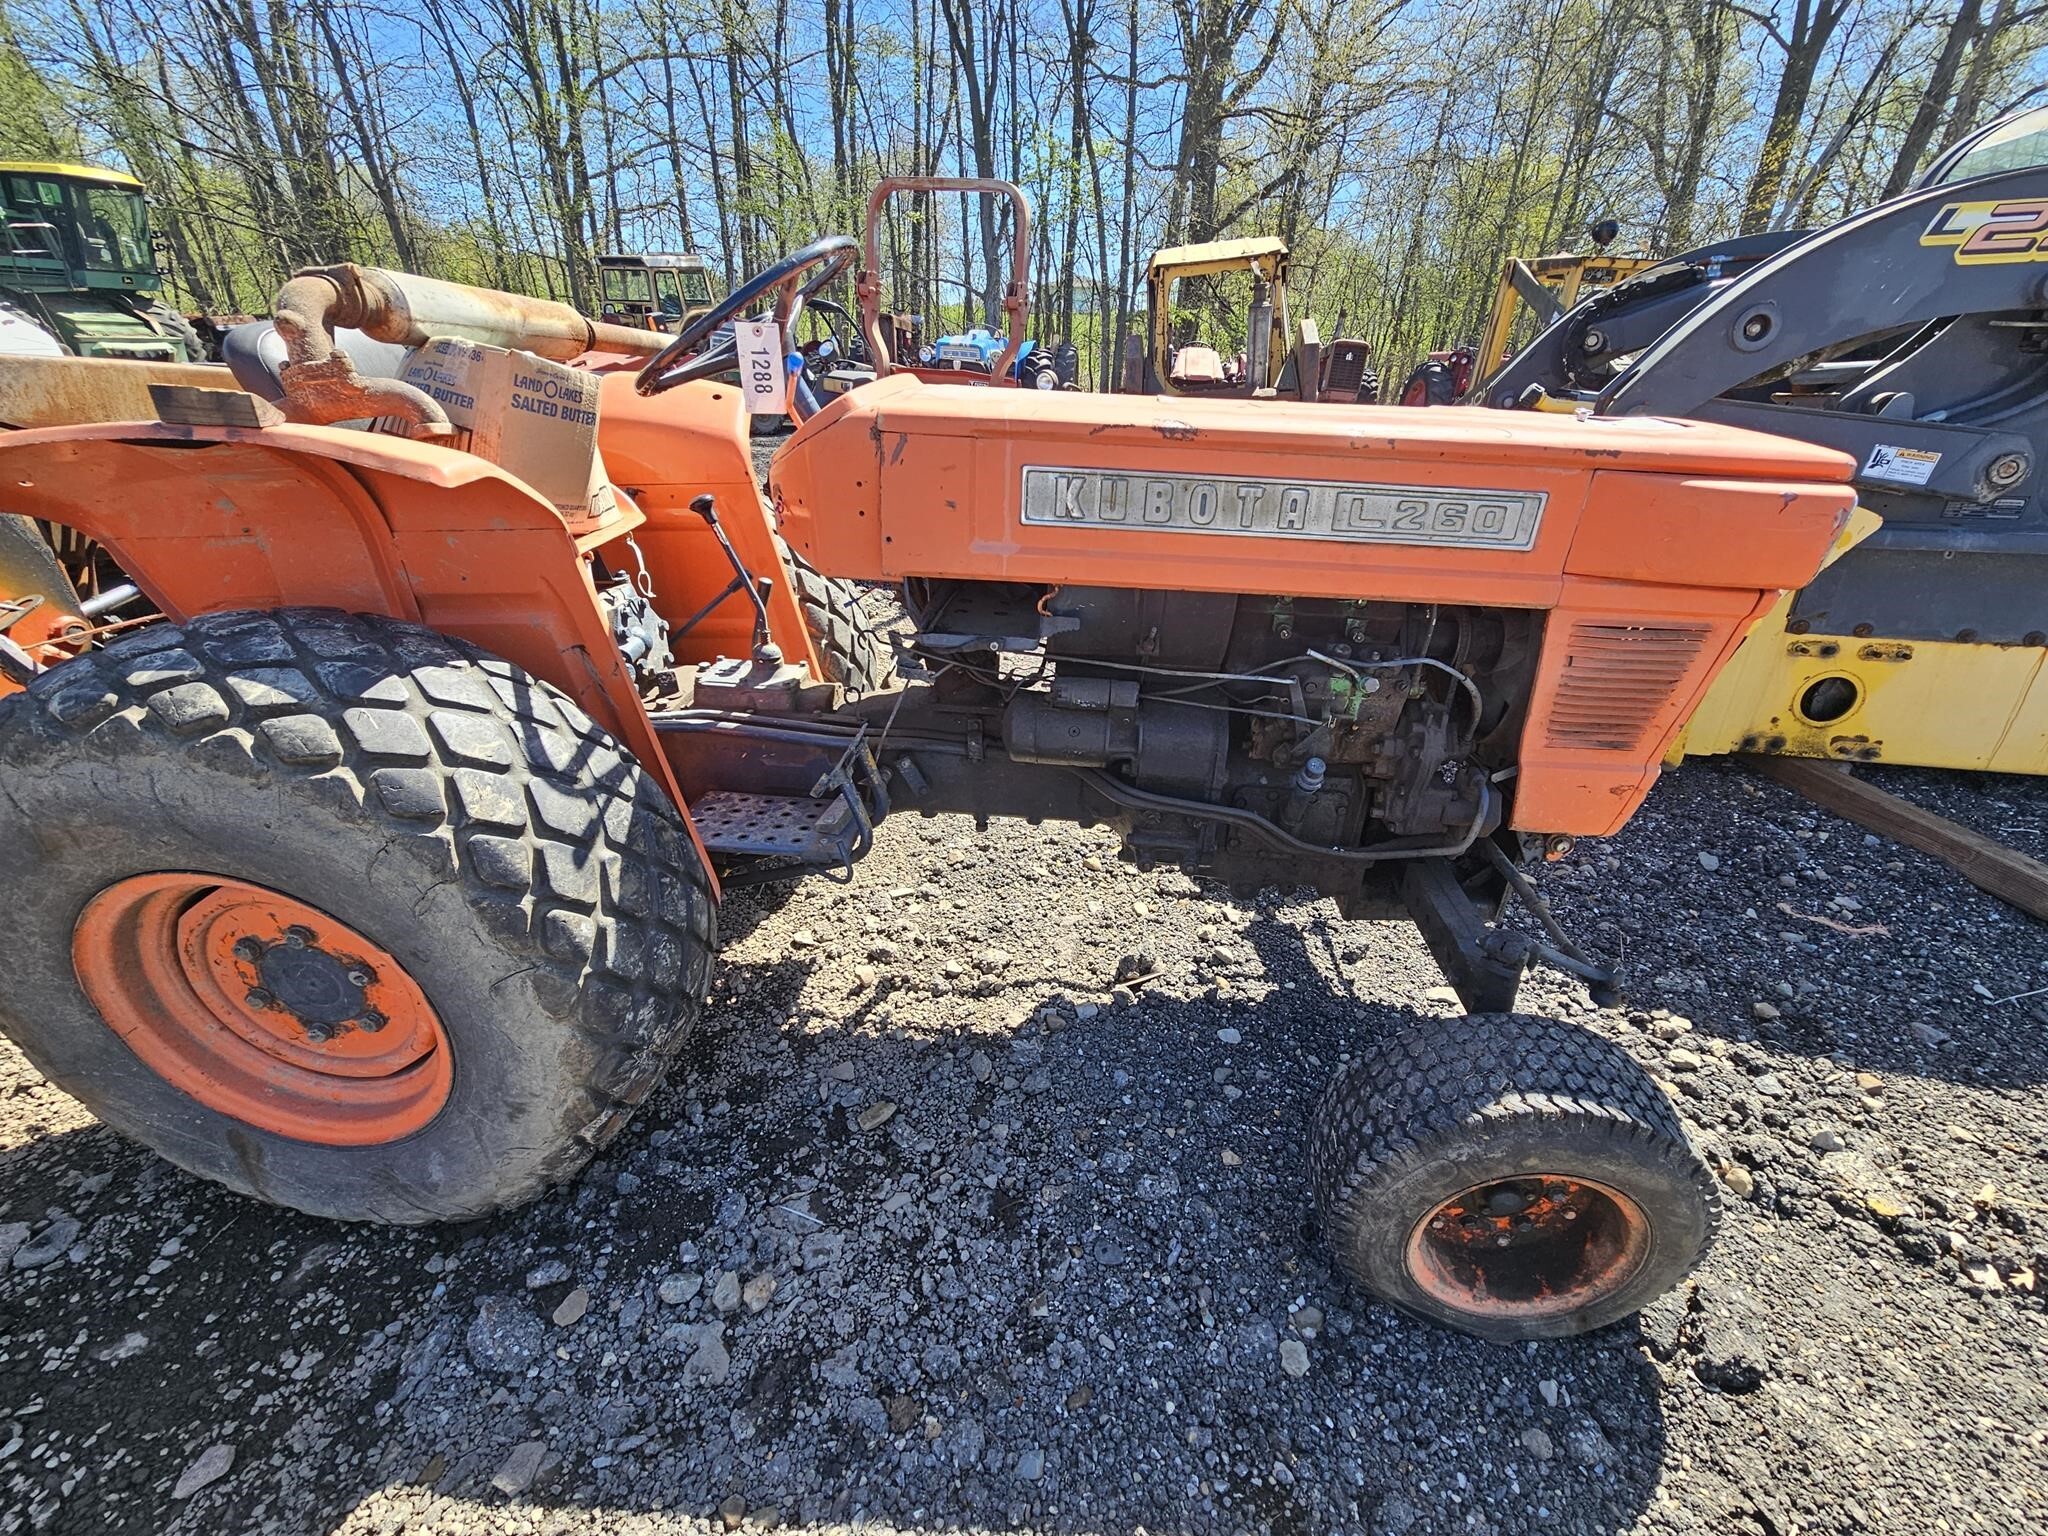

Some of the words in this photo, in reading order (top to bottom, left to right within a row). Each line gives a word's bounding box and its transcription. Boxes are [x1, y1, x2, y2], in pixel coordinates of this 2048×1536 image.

[1922, 200, 2048, 260] L2
[513, 373, 543, 393] LAND
[544, 380, 558, 398] O
[558, 386, 584, 404] LAKES
[750, 347, 773, 394] 1288
[432, 387, 475, 410] BUTTER
[511, 393, 558, 417] SALTED
[561, 405, 597, 426] BUTTER
[1053, 475, 1310, 530] KUBOTA
[1347, 497, 1508, 535] L260
